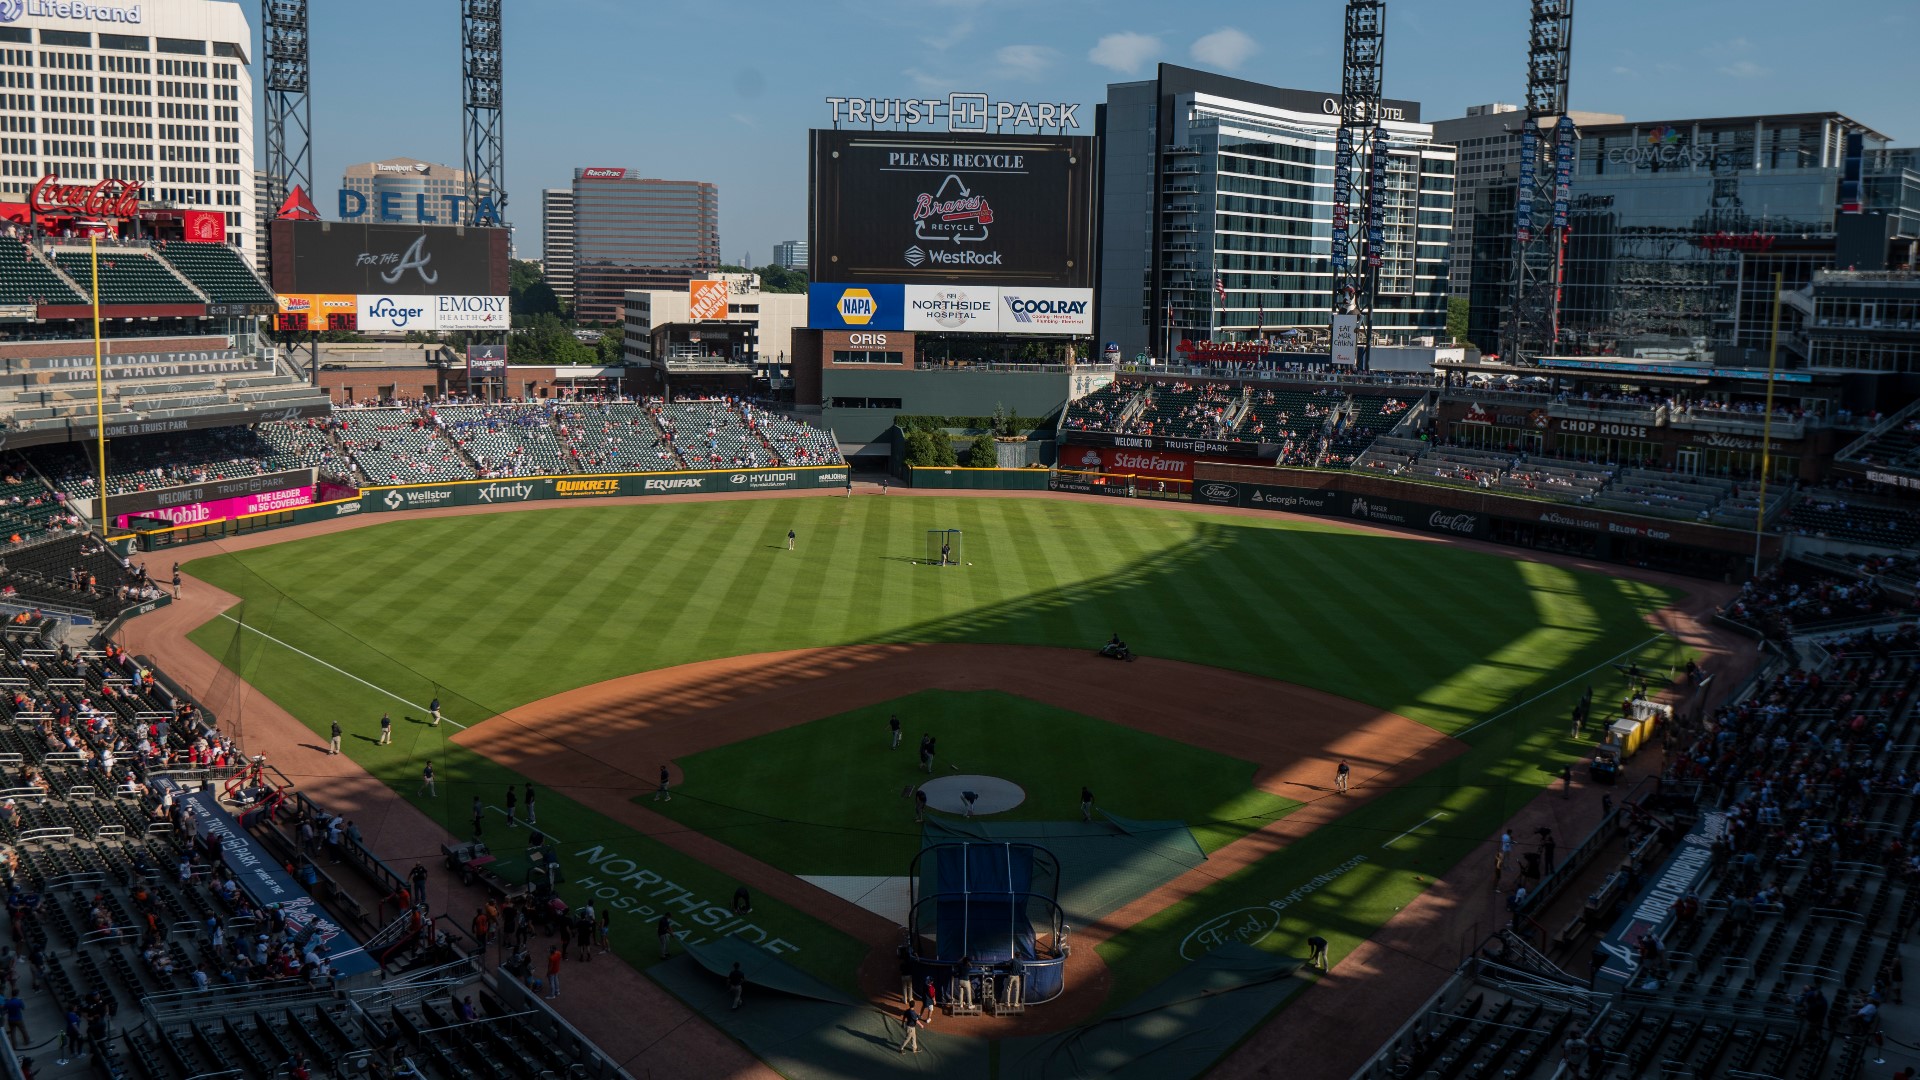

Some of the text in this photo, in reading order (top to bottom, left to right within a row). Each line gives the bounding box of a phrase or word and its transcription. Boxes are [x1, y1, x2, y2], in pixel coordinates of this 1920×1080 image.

[28, 0, 142, 24] LifeBrand
[826, 97, 1081, 128] TRUIST PARK
[889, 152, 1025, 169] PLEASE RECYCLE
[1607, 143, 1720, 165] COMCAST
[376, 162, 413, 174] Travelport
[587, 169, 622, 178] RaceTrac
[30, 173, 145, 217] Coca-Cola
[338, 189, 502, 227] DELTA
[913, 192, 981, 221] Braves
[356, 234, 439, 285] FOR THE A
[929, 250, 1004, 265] WestRock
[290, 297, 311, 306] MEGA
[439, 296, 506, 312] EMORY
[691, 281, 728, 319] HOME
[705, 294, 728, 318] DEPOT
[843, 298, 873, 316] NAPA
[911, 301, 991, 311] NORTHSIDE
[1011, 300, 1088, 314] COOLRAY
[211, 306, 228, 314] 6:12
[369, 298, 425, 328] Kroger
[926, 311, 976, 319] HOSPITAL
[849, 333, 888, 345] ORIS
[470, 359, 505, 368] CHAMPIONS
[130, 419, 189, 433] TO TRUIST PARK
[1496, 413, 1526, 425] LIGHT
[1559, 418, 1648, 437] CHOP HOUSE
[1114, 436, 1153, 449] WELCOME TO
[1165, 440, 1229, 452] TRUIST PARK
[1706, 432, 1754, 449] Silver
[644, 478, 704, 490] EQUIFAX
[749, 472, 797, 483] HYUNDAI
[216, 478, 284, 495] TRUIST PARK
[556, 480, 620, 492] QUIKRETE
[1103, 487, 1126, 495] TRUIST
[1206, 484, 1233, 496] Ford
[157, 488, 204, 506] WELCOME TO
[256, 489, 301, 504] THE LEADER
[407, 490, 452, 502] Wellstar
[478, 484, 534, 504] xfinity
[1265, 494, 1325, 508] Georgia Power
[248, 497, 310, 514] IN 5G COVERAGE
[1370, 504, 1389, 513] KAISER
[1428, 509, 1479, 534] Coca-Cola
[1549, 512, 1600, 530] Coors LIGHT
[1607, 521, 1638, 534] BELOW
[1646, 528, 1672, 541] CHOP
[231, 847, 261, 867] PARK
[1270, 853, 1370, 910] BuyFordNow.com
[1631, 846, 1713, 925] WORLD CHAMPIONS
